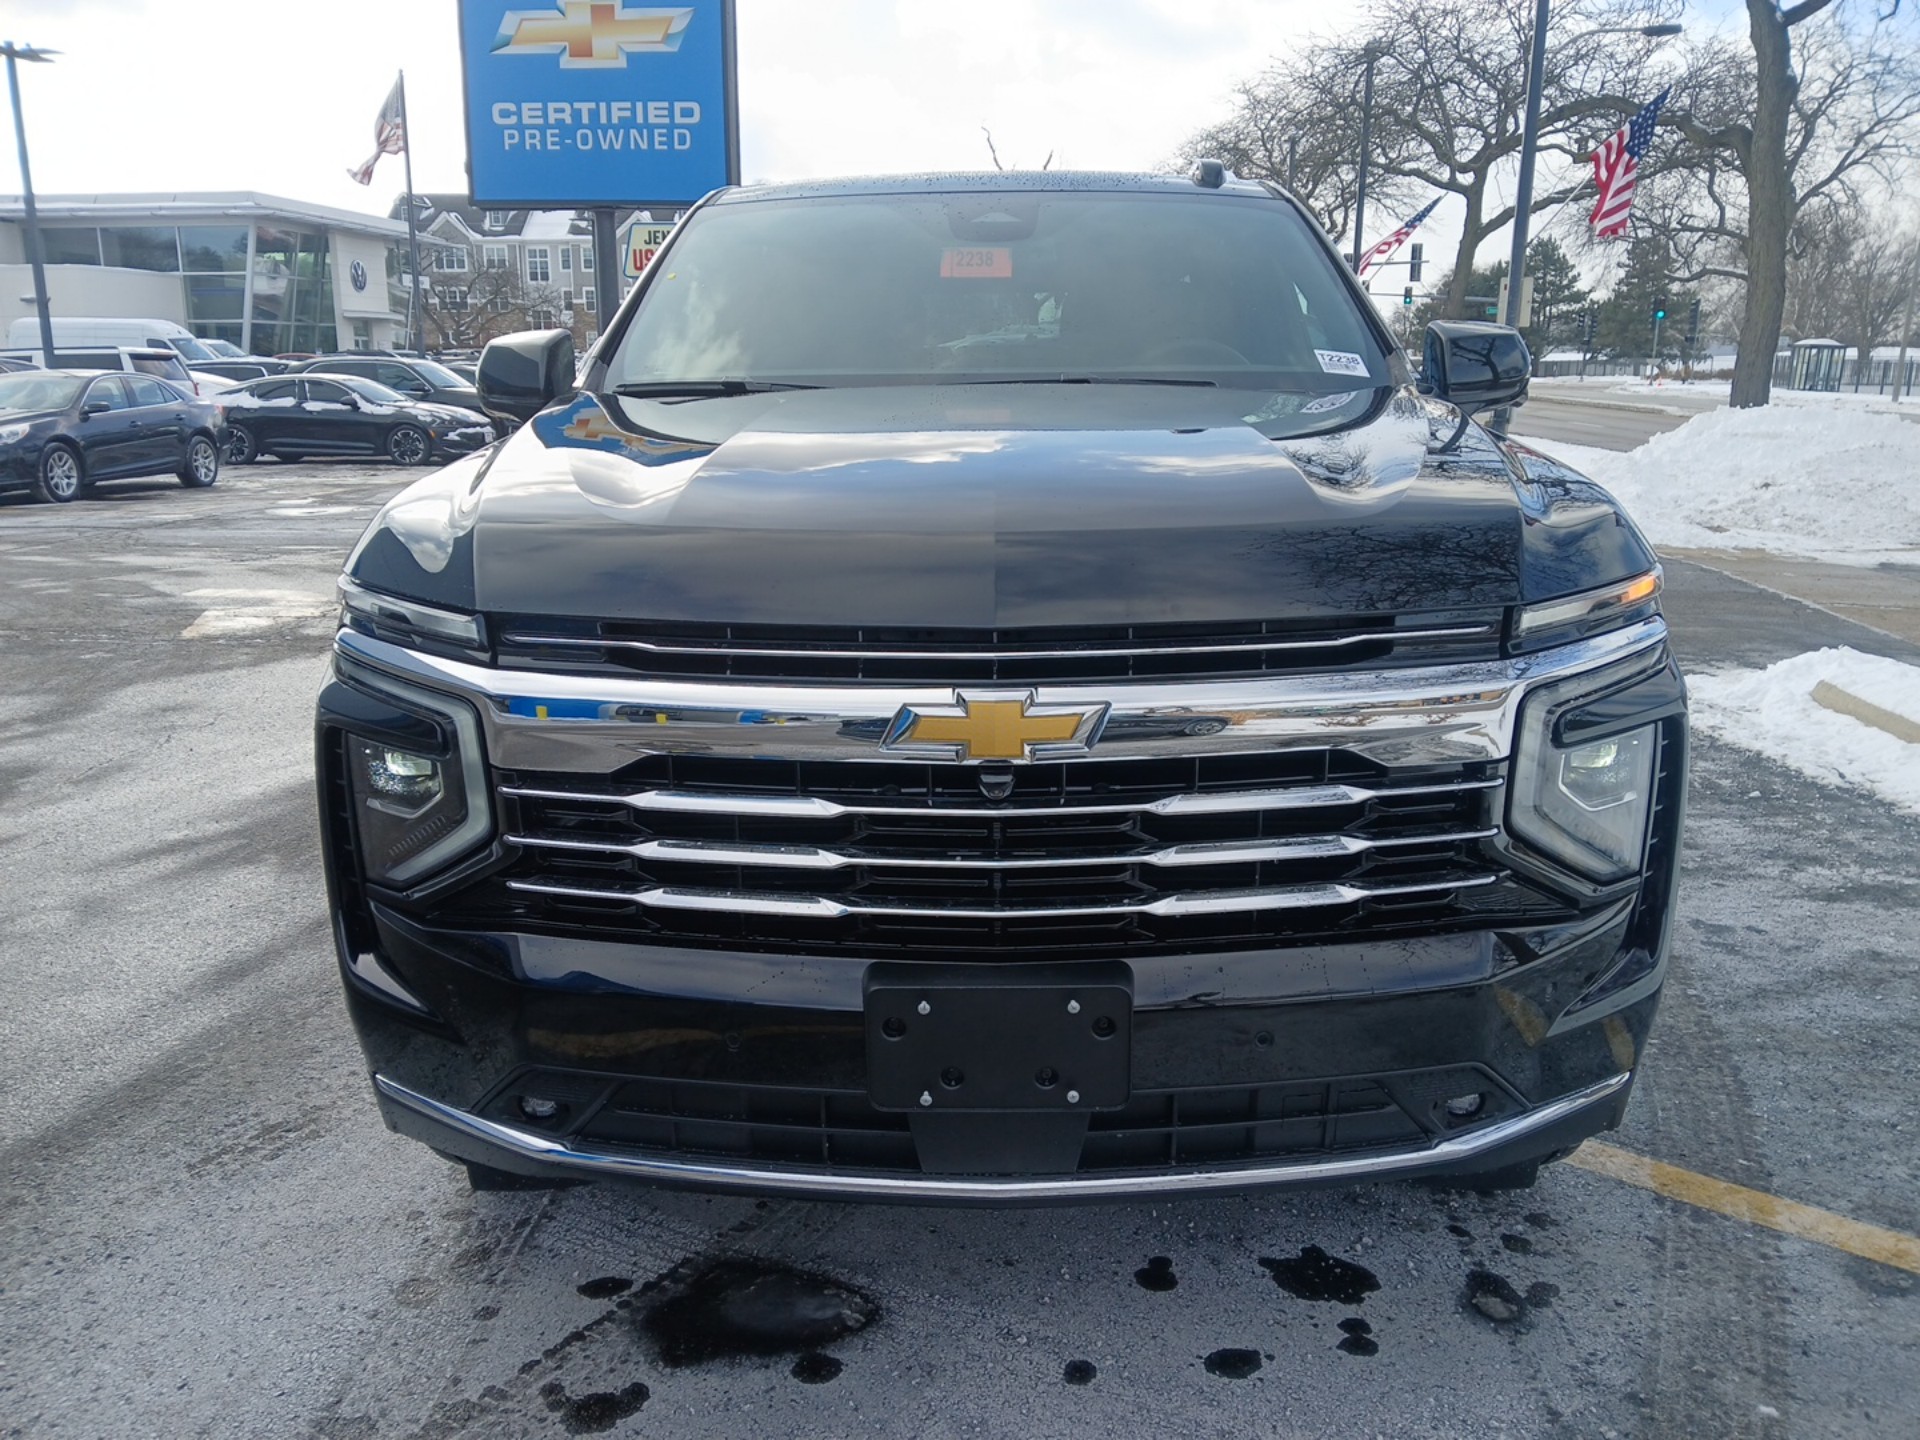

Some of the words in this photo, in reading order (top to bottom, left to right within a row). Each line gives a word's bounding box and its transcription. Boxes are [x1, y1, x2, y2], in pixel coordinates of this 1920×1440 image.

[492, 102, 700, 124] CERTIFIED
[504, 129, 691, 150] PRE-OWNED
[956, 251, 994, 267] 2238
[1318, 353, 1360, 365] T2238
